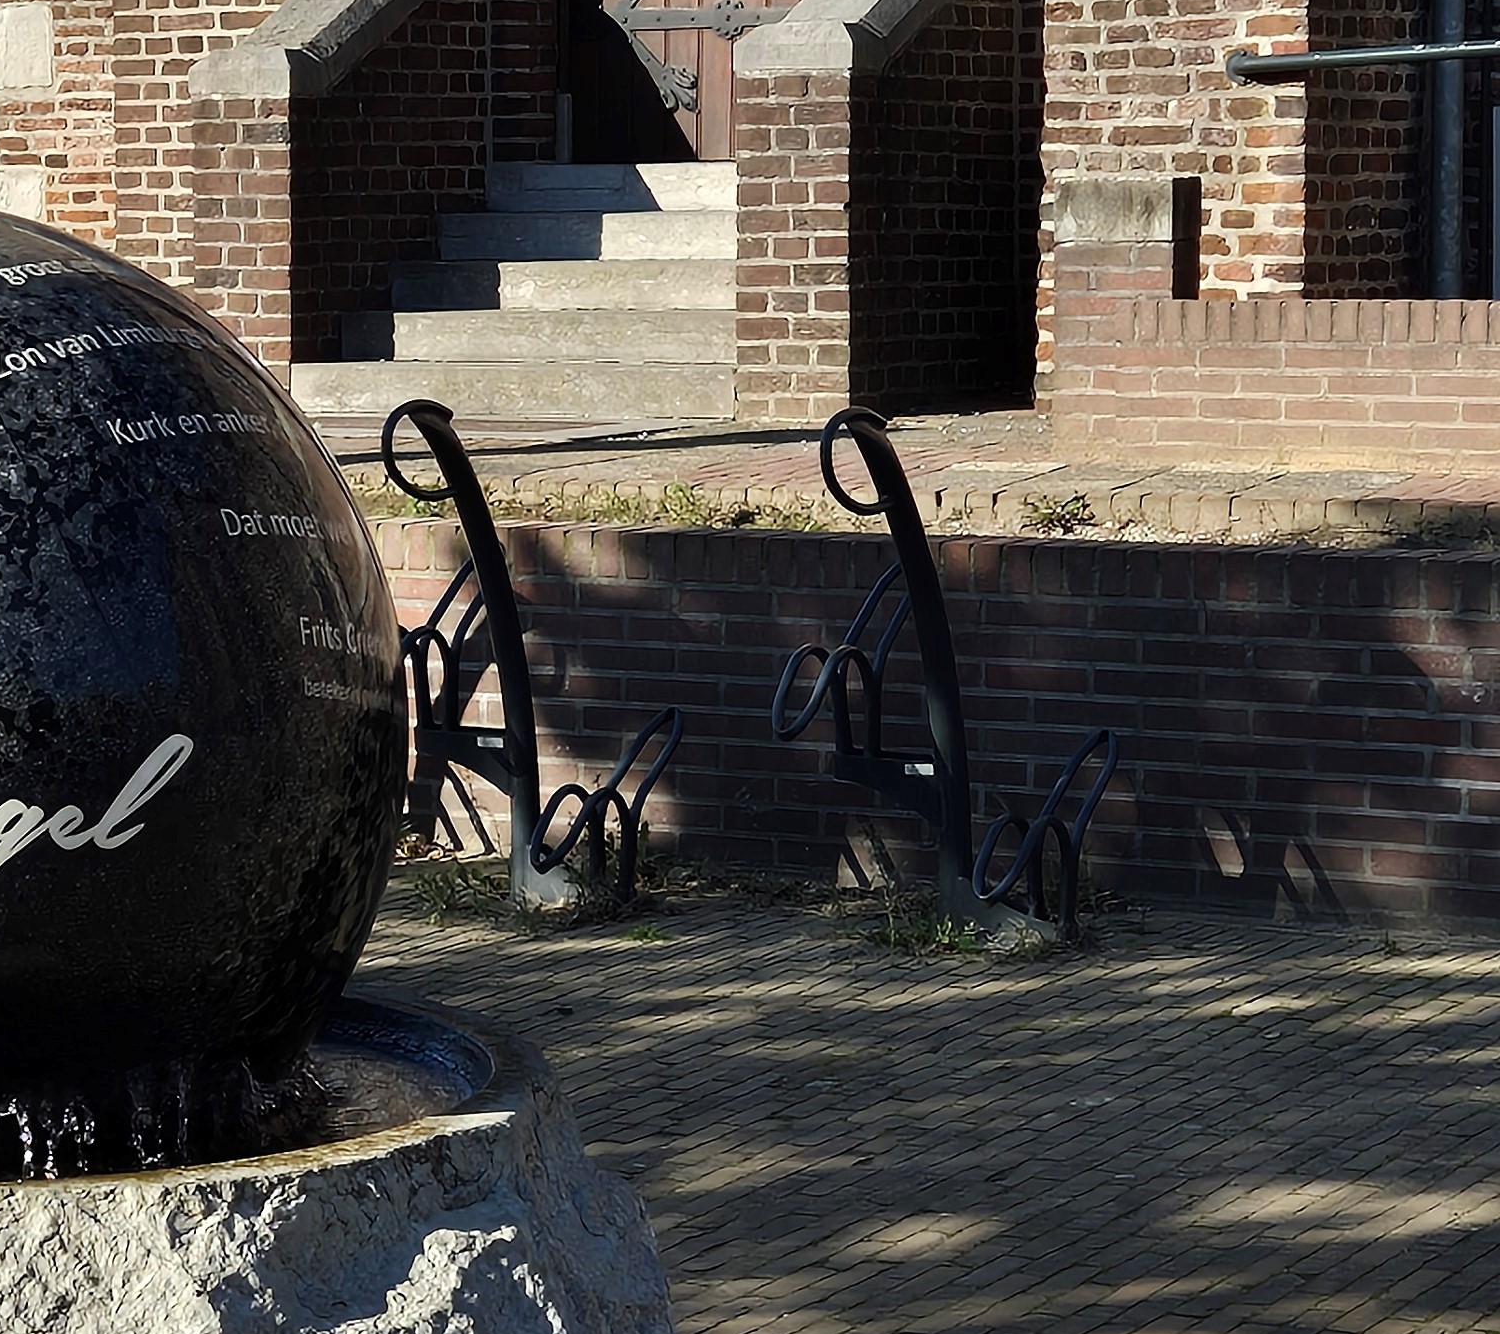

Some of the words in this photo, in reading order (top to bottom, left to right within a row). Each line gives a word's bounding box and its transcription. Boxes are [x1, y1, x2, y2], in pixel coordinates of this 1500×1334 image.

[45, 330, 101, 360] van
[105, 411, 176, 445] Kurk
[177, 413, 212, 435] en
[219, 508, 268, 536] Dat
[299, 617, 343, 651] Frits
